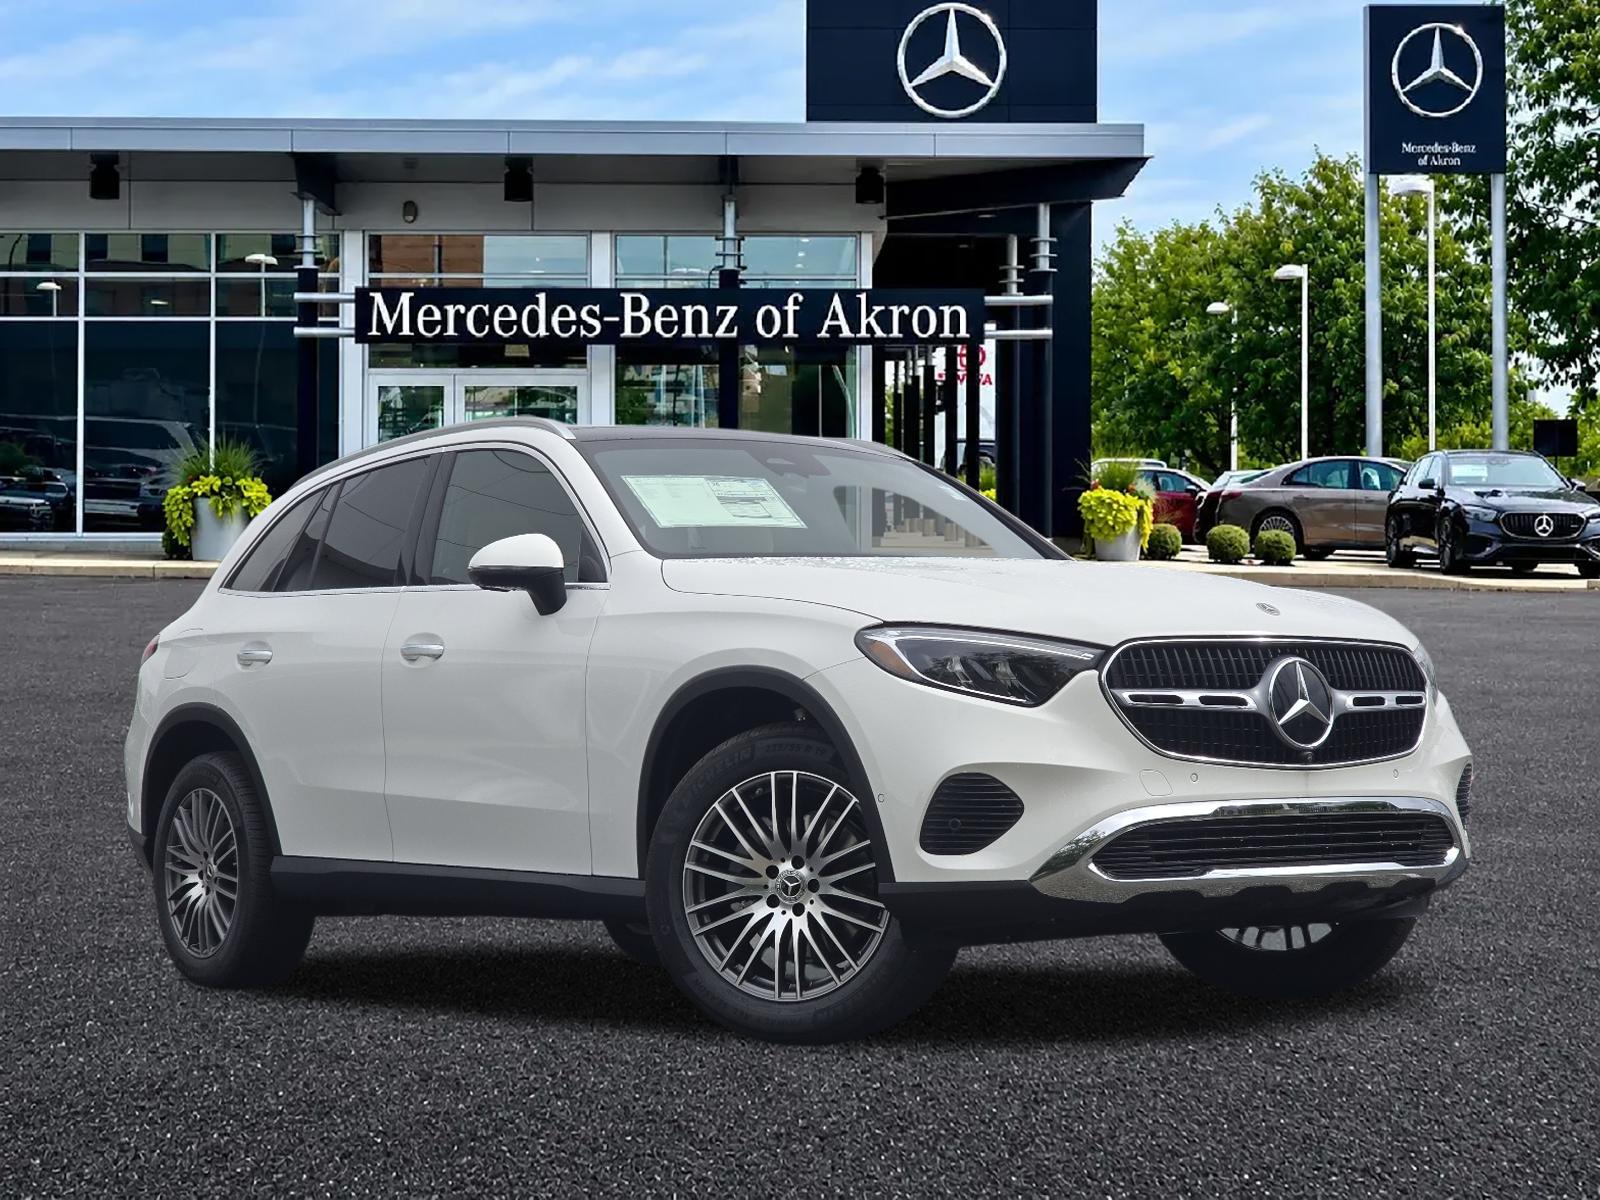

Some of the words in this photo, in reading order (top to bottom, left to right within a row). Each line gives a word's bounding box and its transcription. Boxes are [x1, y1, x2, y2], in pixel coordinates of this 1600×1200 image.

[1401, 141, 1476, 153] Mercedes-Benz
[1417, 154, 1428, 166] of
[1430, 154, 1461, 166] Akron
[367, 291, 738, 338] Mercedes-Benz
[755, 292, 804, 338] of
[816, 291, 970, 338] Akron
